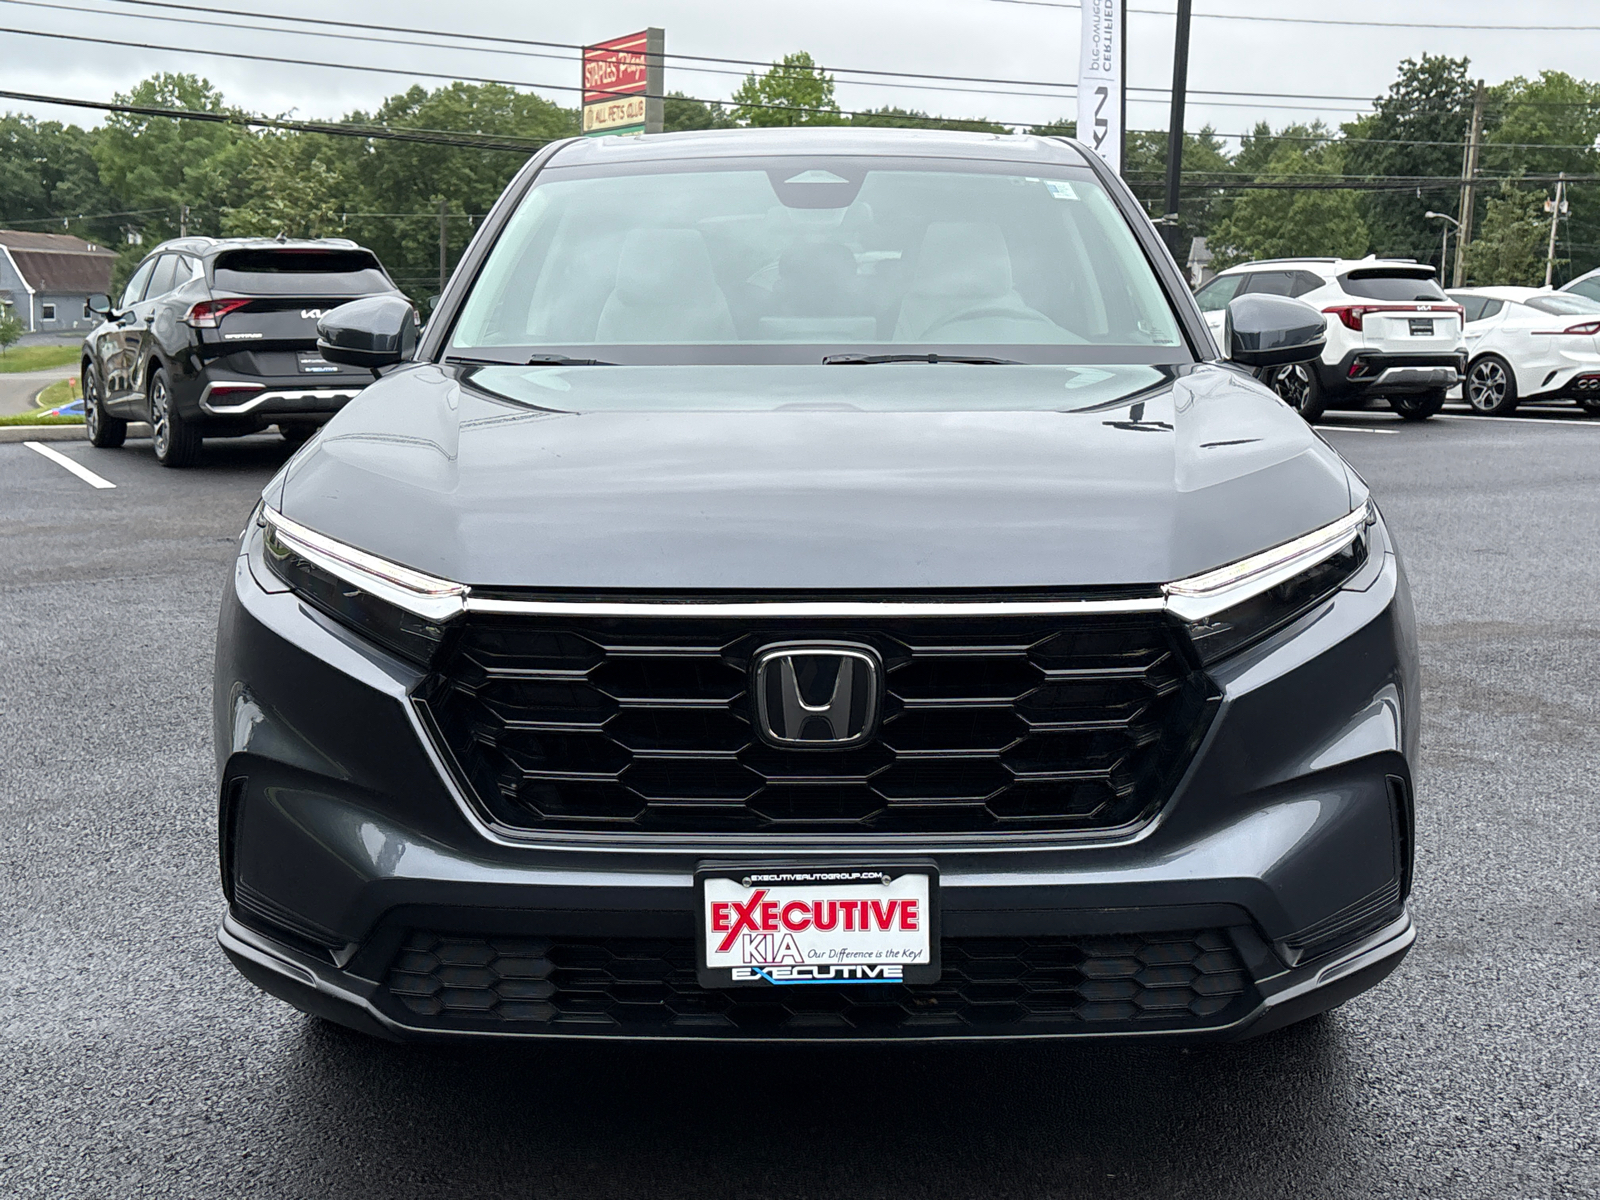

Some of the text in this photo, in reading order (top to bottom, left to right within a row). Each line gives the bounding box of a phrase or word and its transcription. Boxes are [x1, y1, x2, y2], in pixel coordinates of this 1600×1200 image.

[585, 55, 618, 88] STAPLES
[595, 99, 644, 124] ALL PETS CLUB
[750, 871, 883, 882] EXECUTIVEAUTOGROUP.COM
[711, 888, 920, 953] EXECUTIVE
[742, 933, 805, 964] KIA
[807, 947, 923, 964] Our Difference is the Key!
[731, 965, 903, 981] EXECUTIVE
